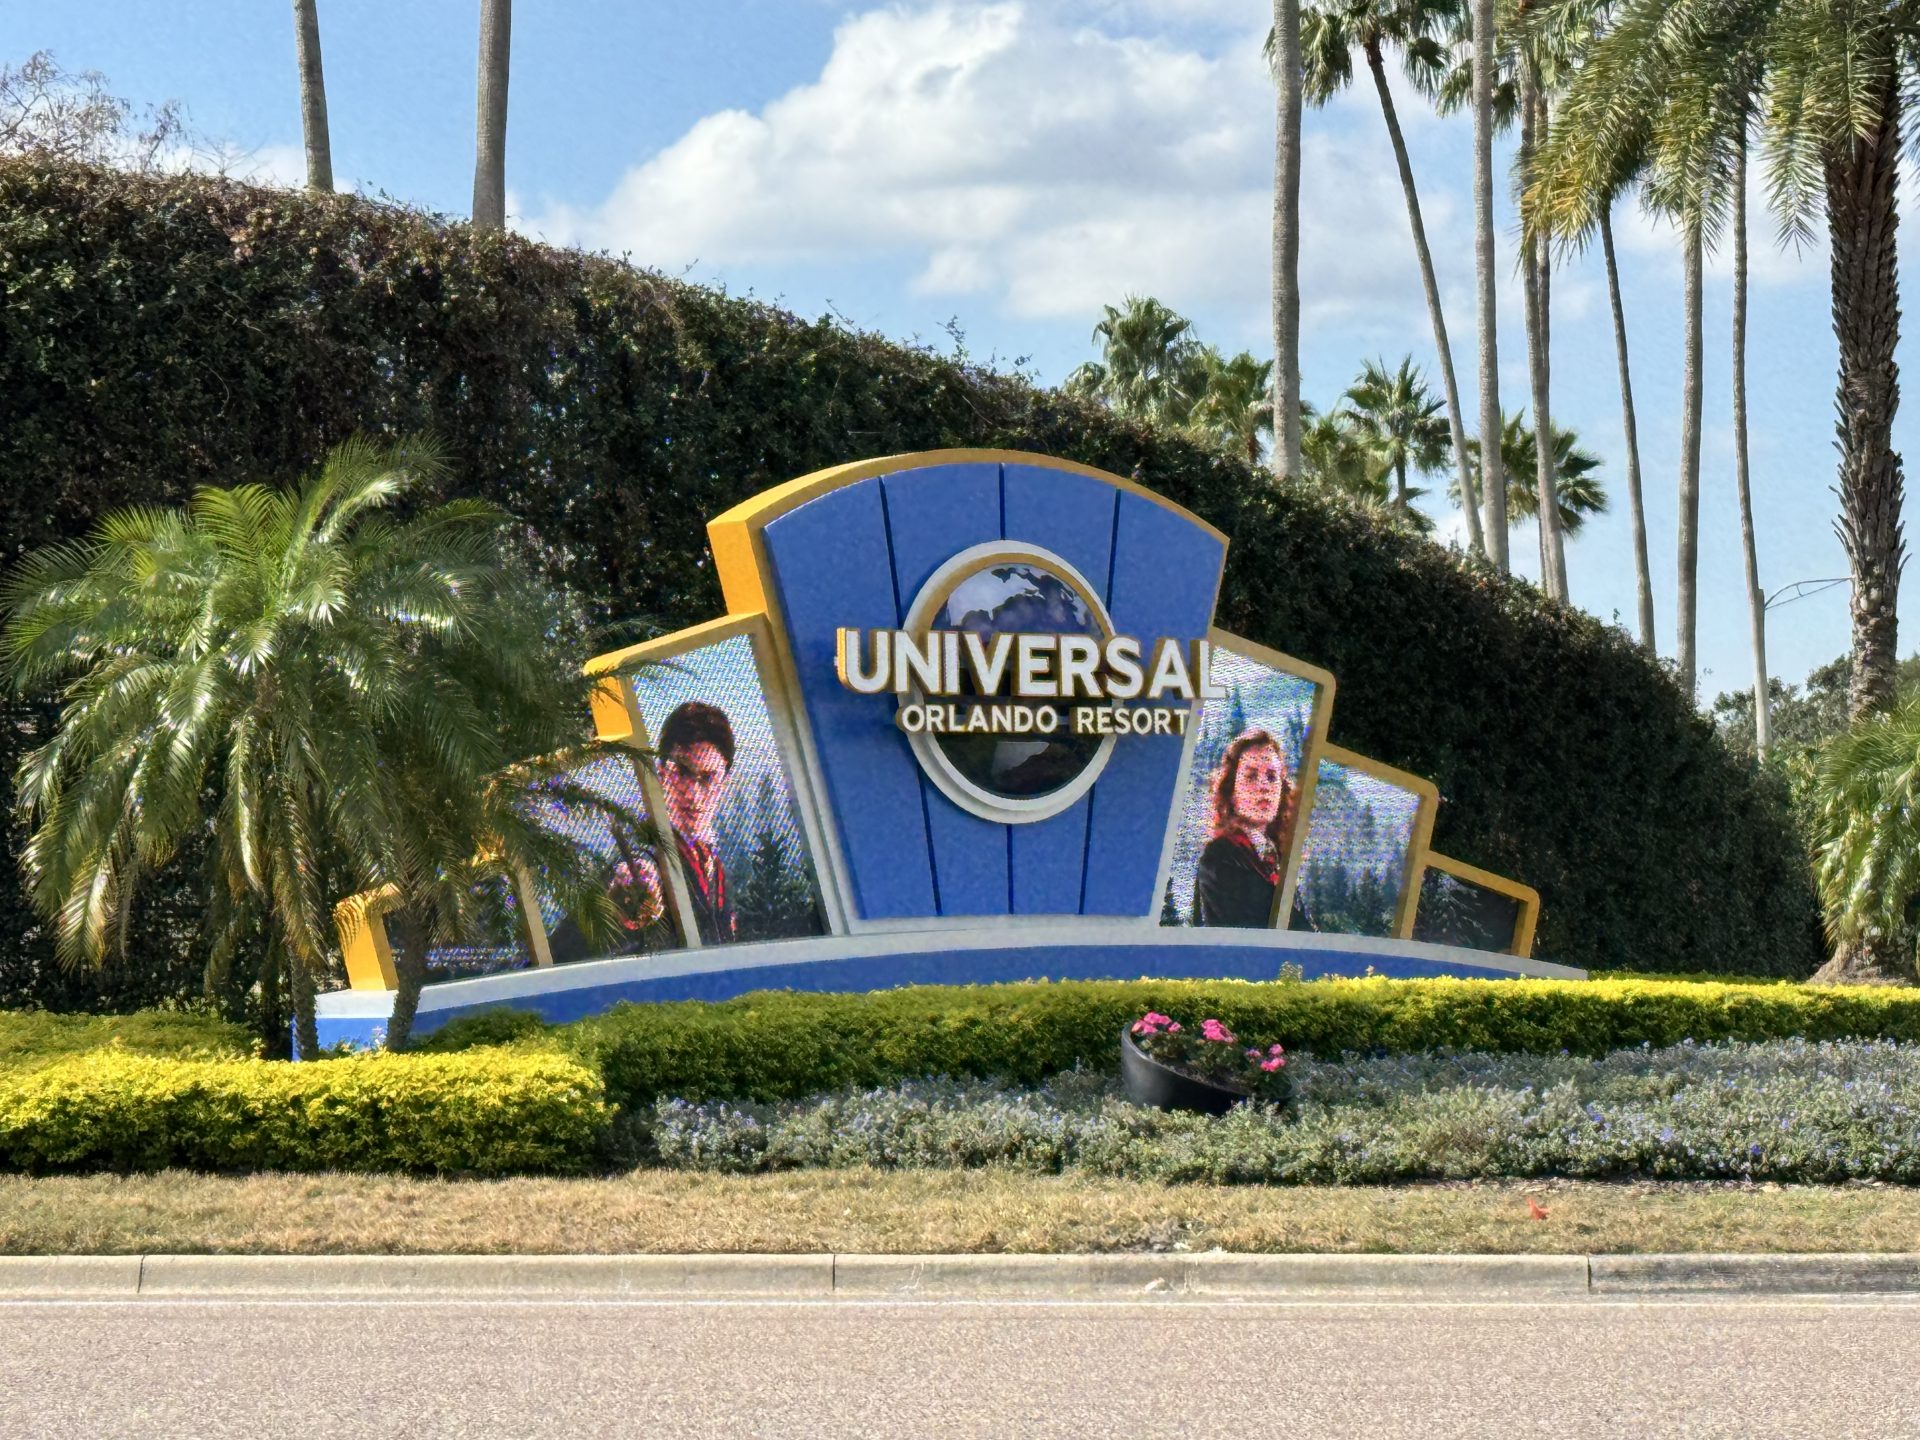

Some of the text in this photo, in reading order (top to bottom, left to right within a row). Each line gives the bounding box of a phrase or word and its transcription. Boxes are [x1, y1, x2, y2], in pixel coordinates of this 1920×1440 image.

[836, 627, 1227, 698] UNIVERSAL
[899, 703, 1190, 736] ORLANDO RESORT
